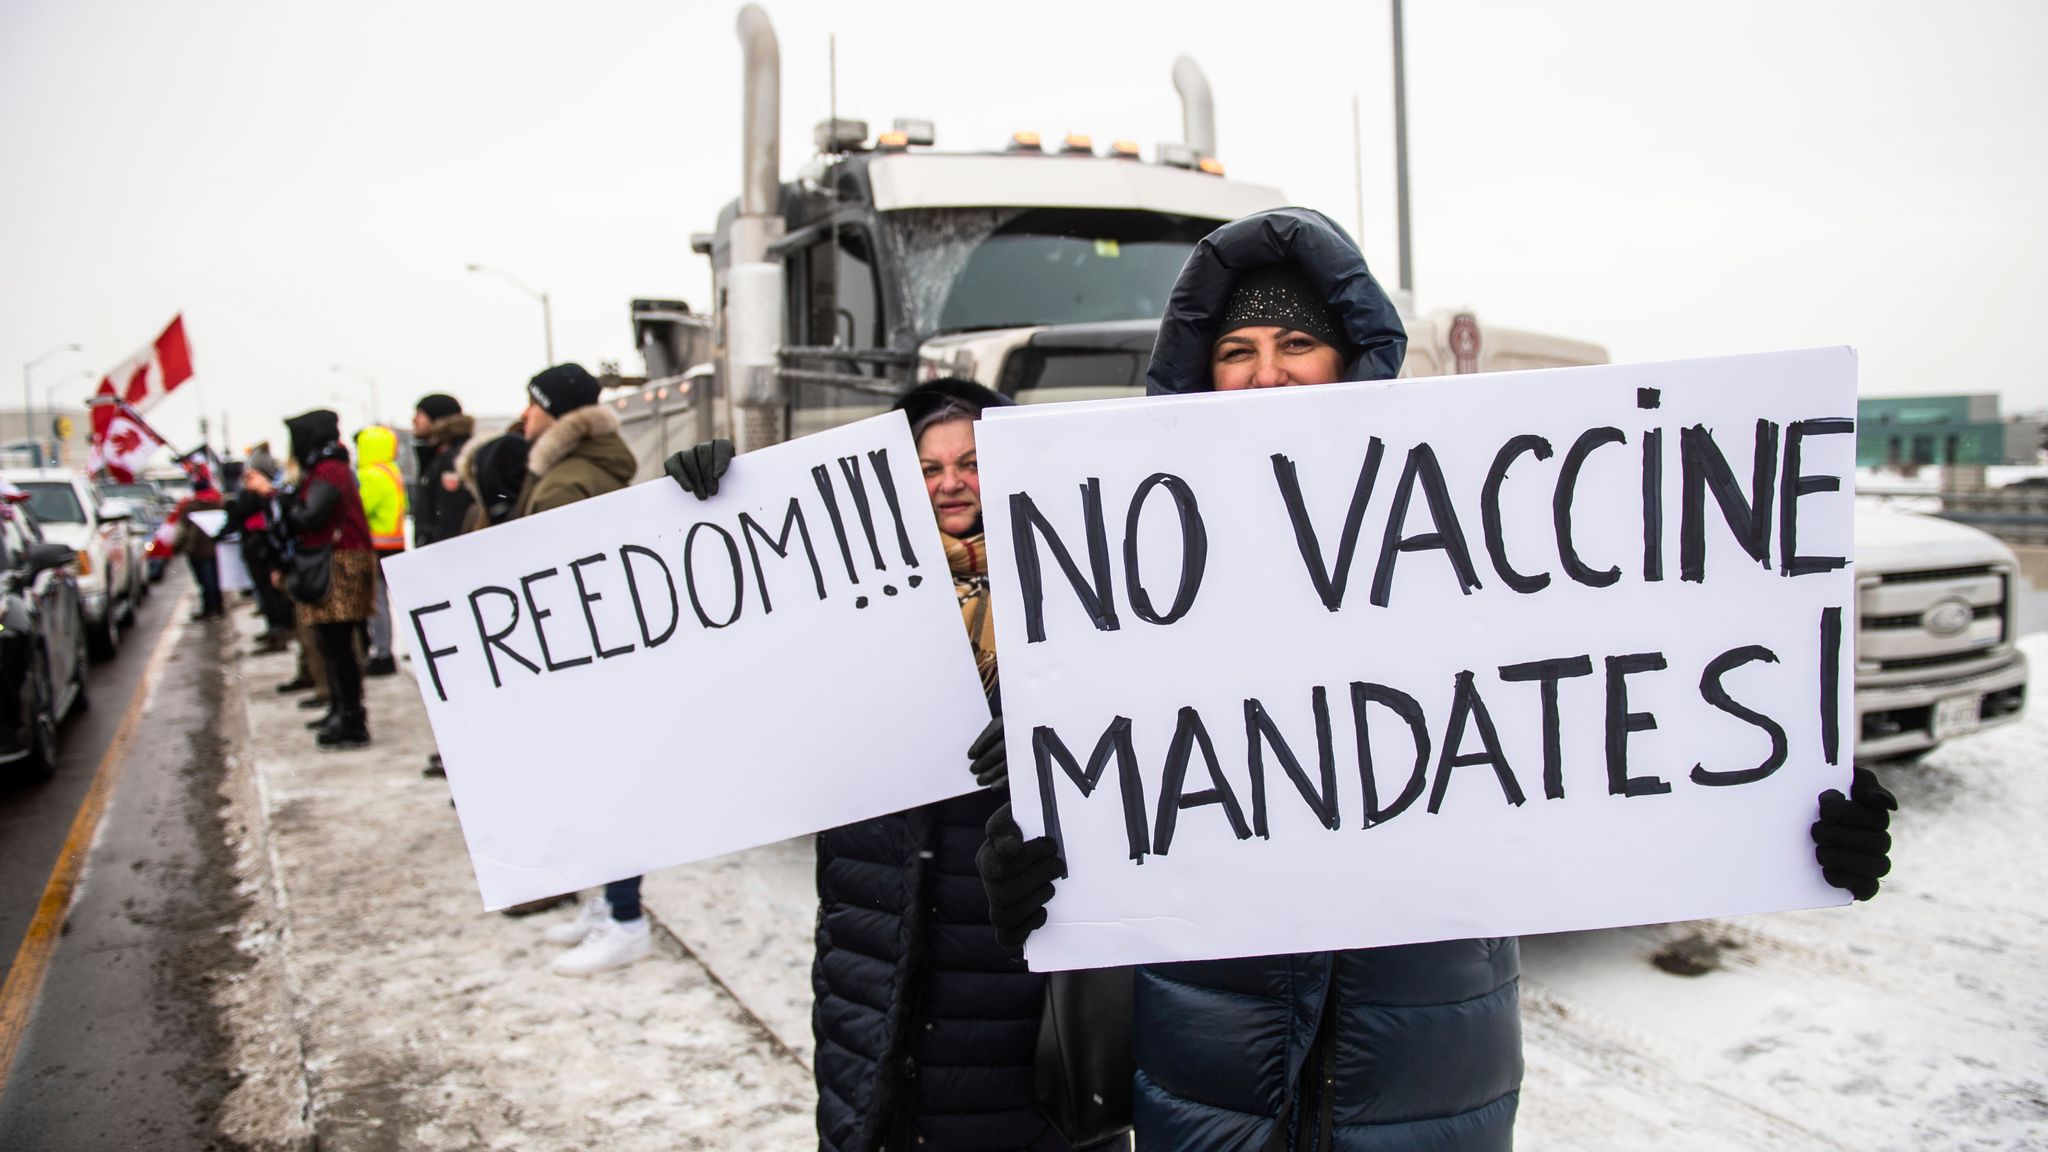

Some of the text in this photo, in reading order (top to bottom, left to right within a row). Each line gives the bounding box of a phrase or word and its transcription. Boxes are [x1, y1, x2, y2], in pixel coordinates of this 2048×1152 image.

[409, 448, 924, 702] FREEDOM!!!
[1008, 471, 1208, 645] NO
[1031, 606, 1843, 879] MANDATES!
